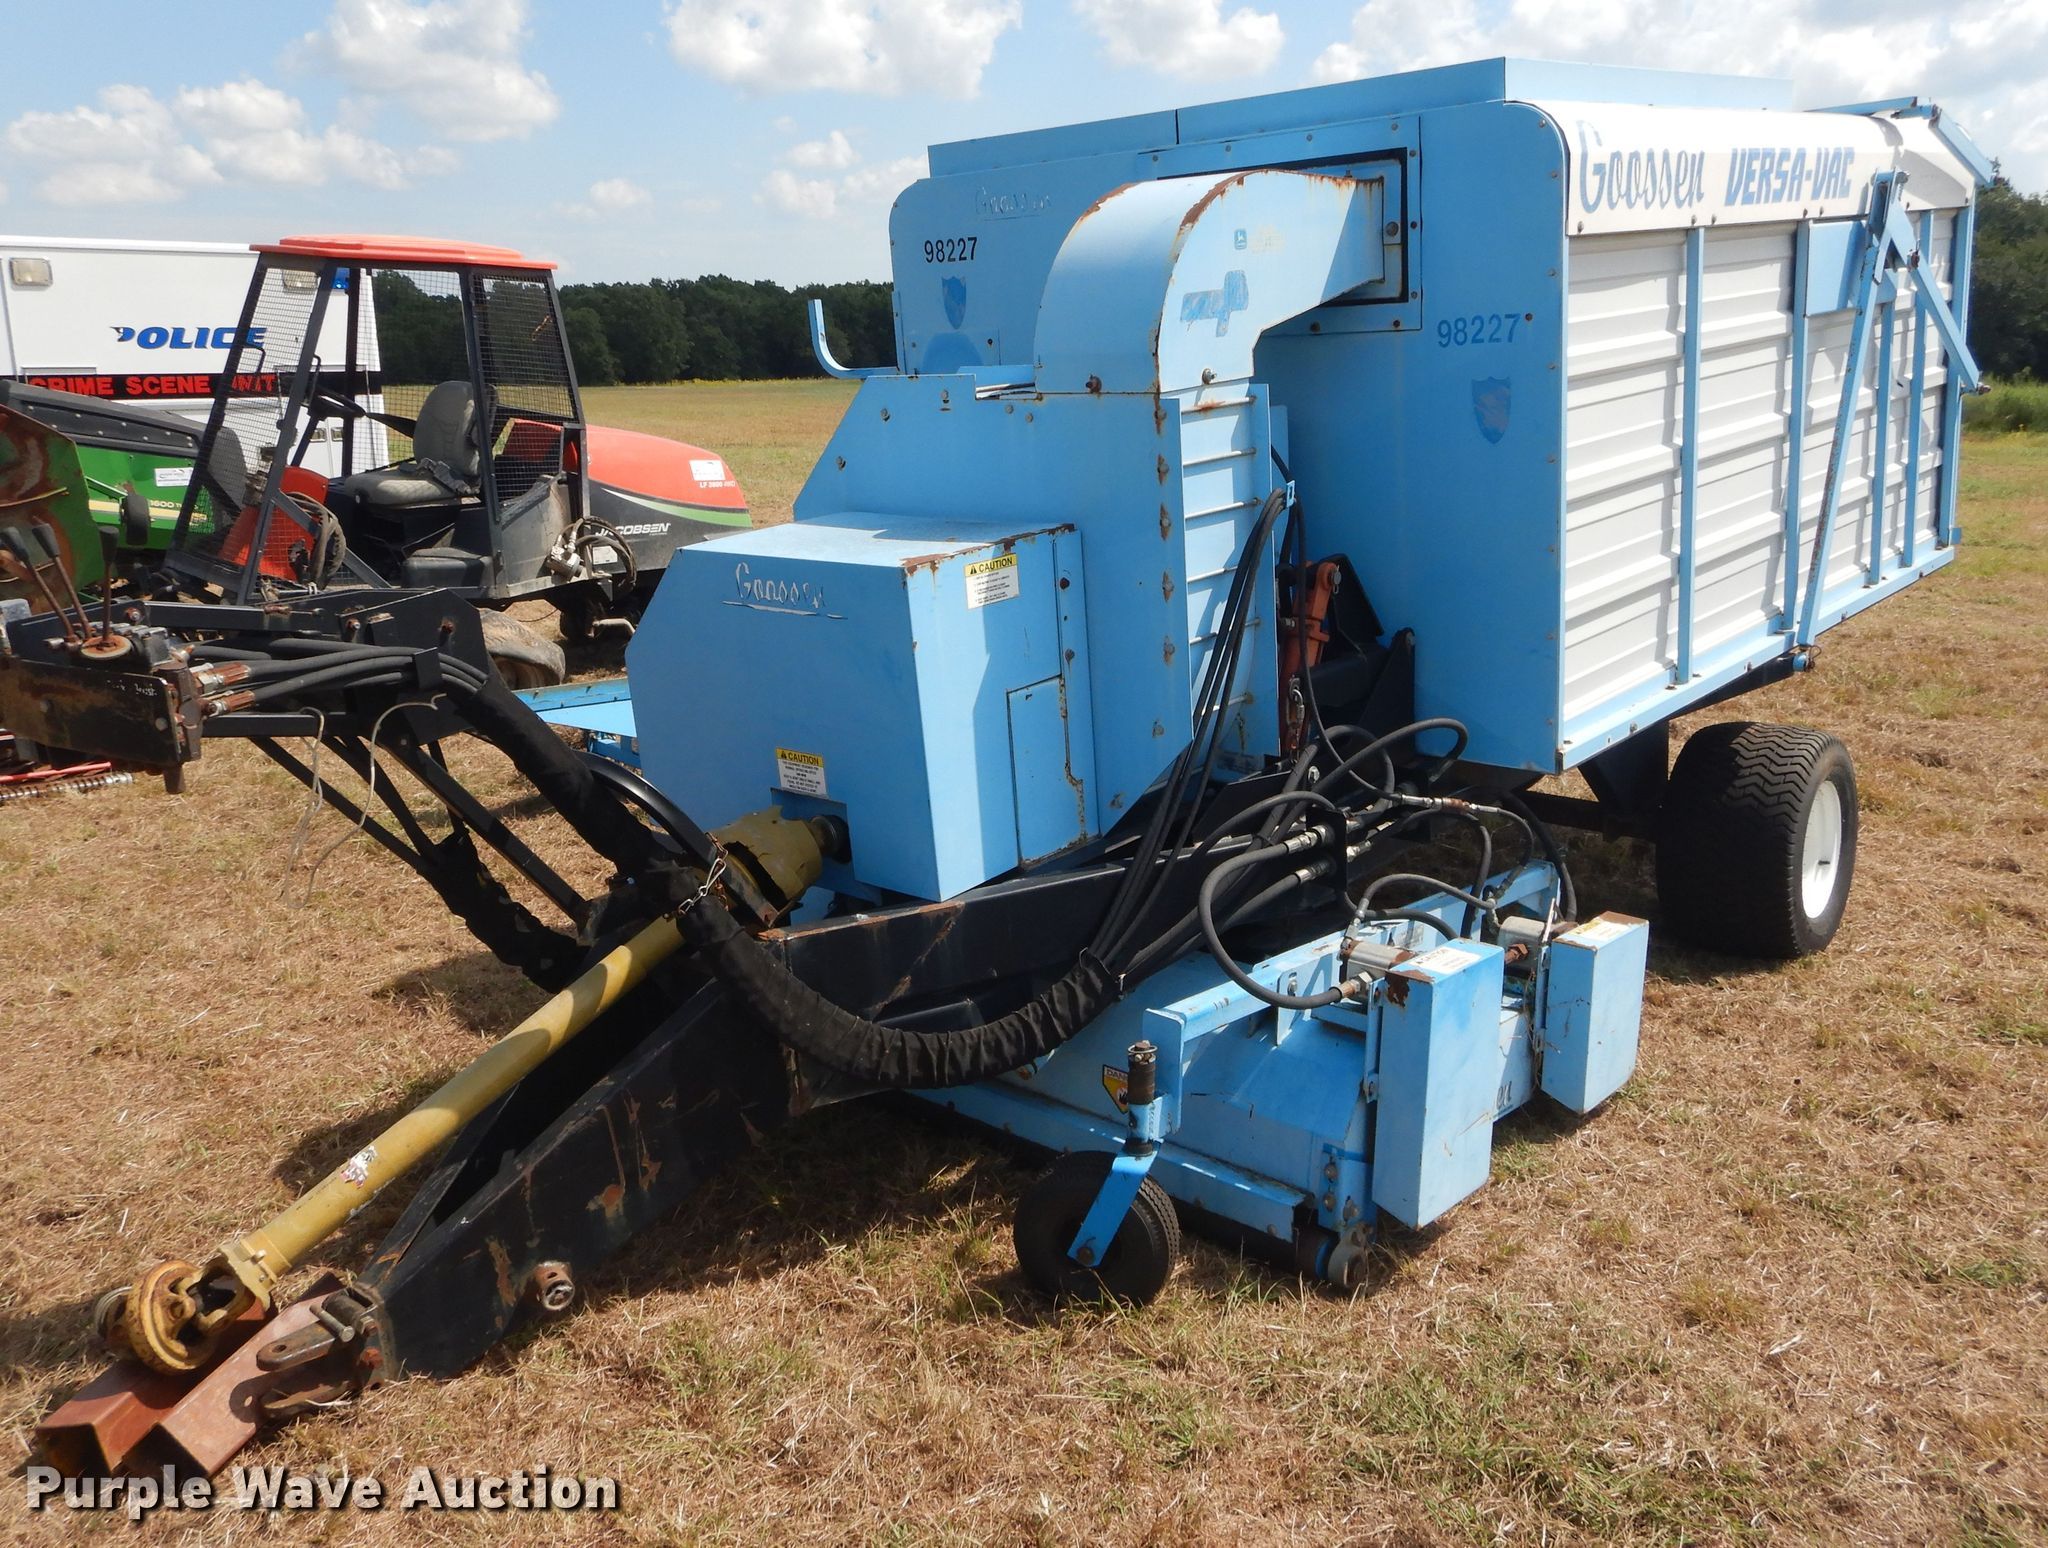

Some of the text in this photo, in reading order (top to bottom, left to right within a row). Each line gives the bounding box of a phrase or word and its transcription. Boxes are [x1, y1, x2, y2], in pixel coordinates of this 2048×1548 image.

[1575, 119, 1855, 214] Goossen VERSA-VAC
[924, 236, 978, 263] 98227
[109, 326, 268, 349] POLICE
[1437, 313, 1521, 348] 98227
[126, 375, 211, 395] SCENE
[978, 557, 1013, 573] CAUTION
[788, 752, 819, 766] CAUTION
